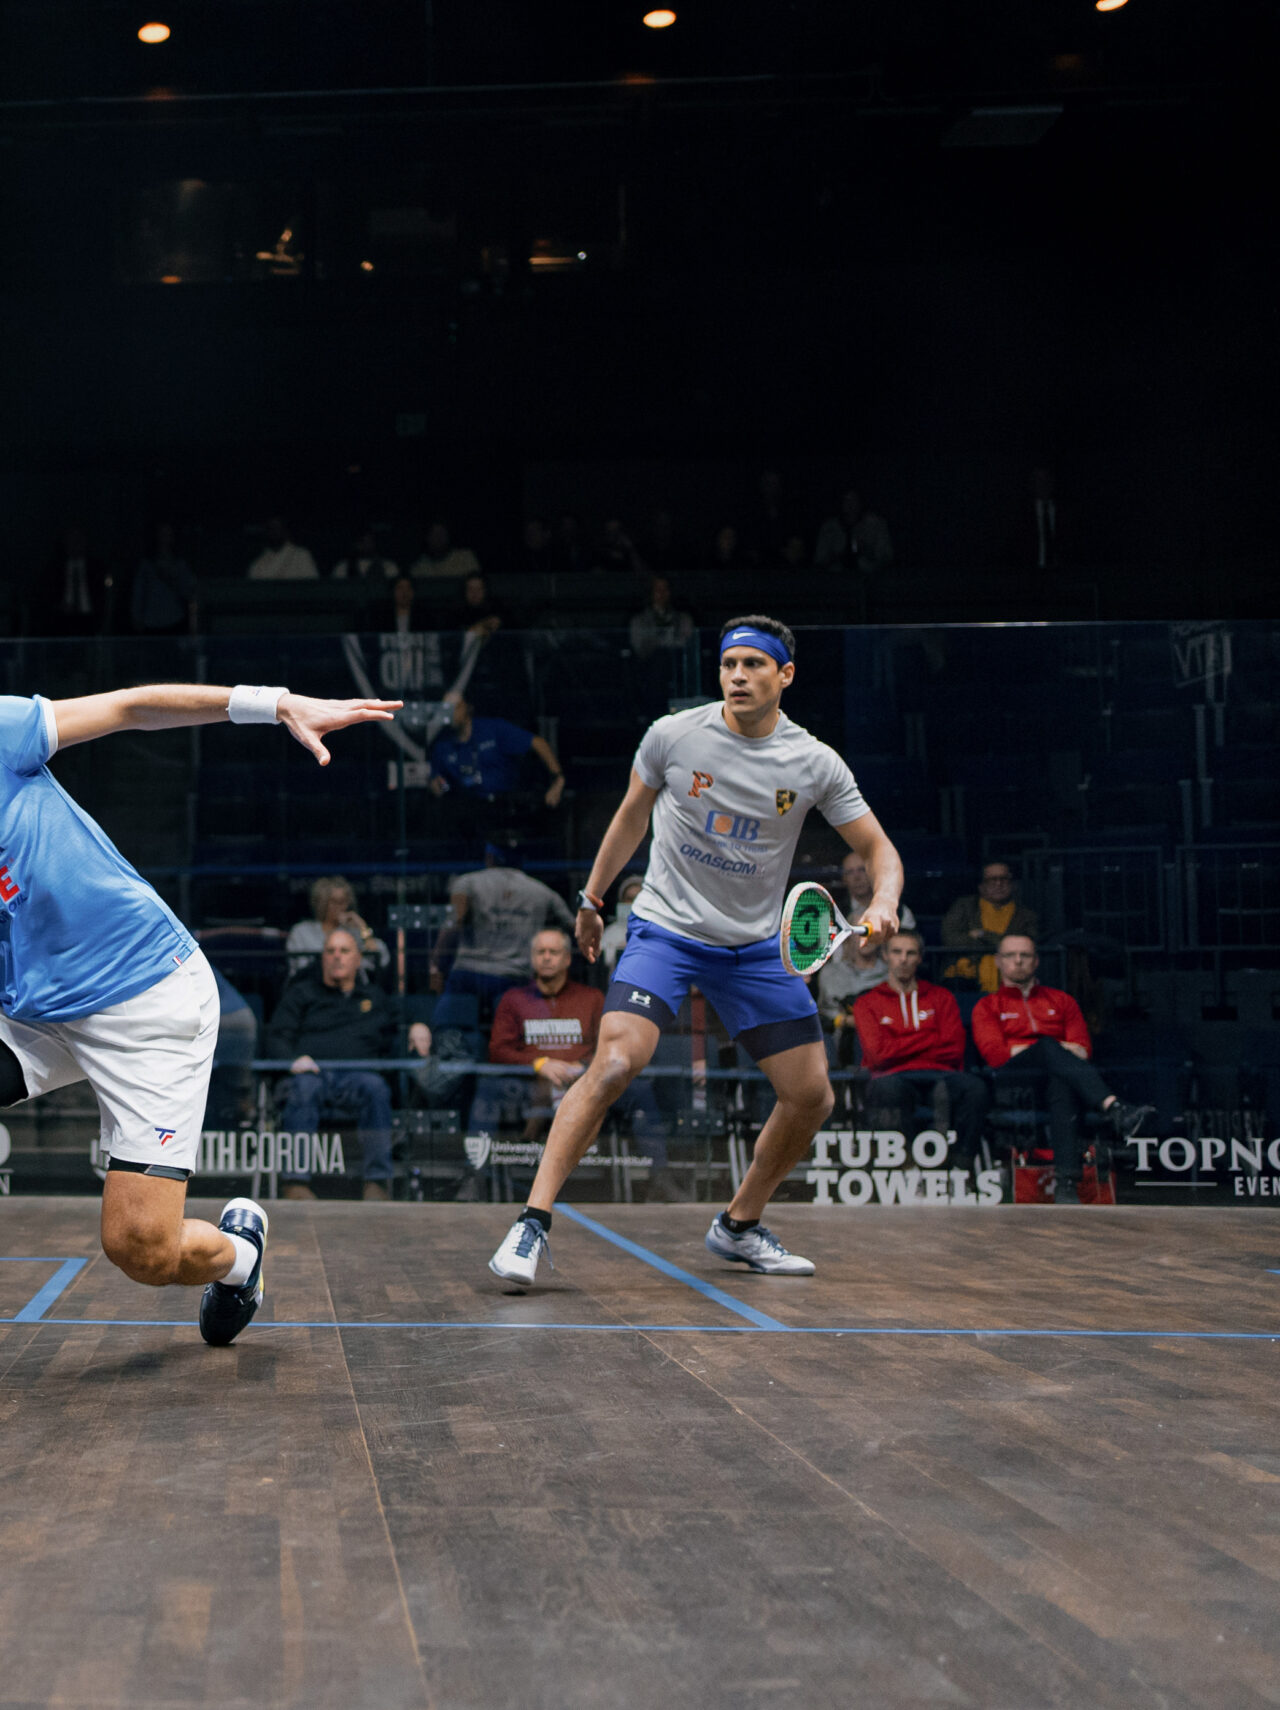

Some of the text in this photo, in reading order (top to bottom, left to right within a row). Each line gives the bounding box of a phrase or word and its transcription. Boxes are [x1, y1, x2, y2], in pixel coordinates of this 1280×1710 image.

[688, 770, 714, 798] P
[680, 843, 757, 875] ORASCOM
[241, 1131, 345, 1174] CORONA
[811, 1131, 907, 1168] TUB
[806, 1169, 1004, 1207] TOWELS
